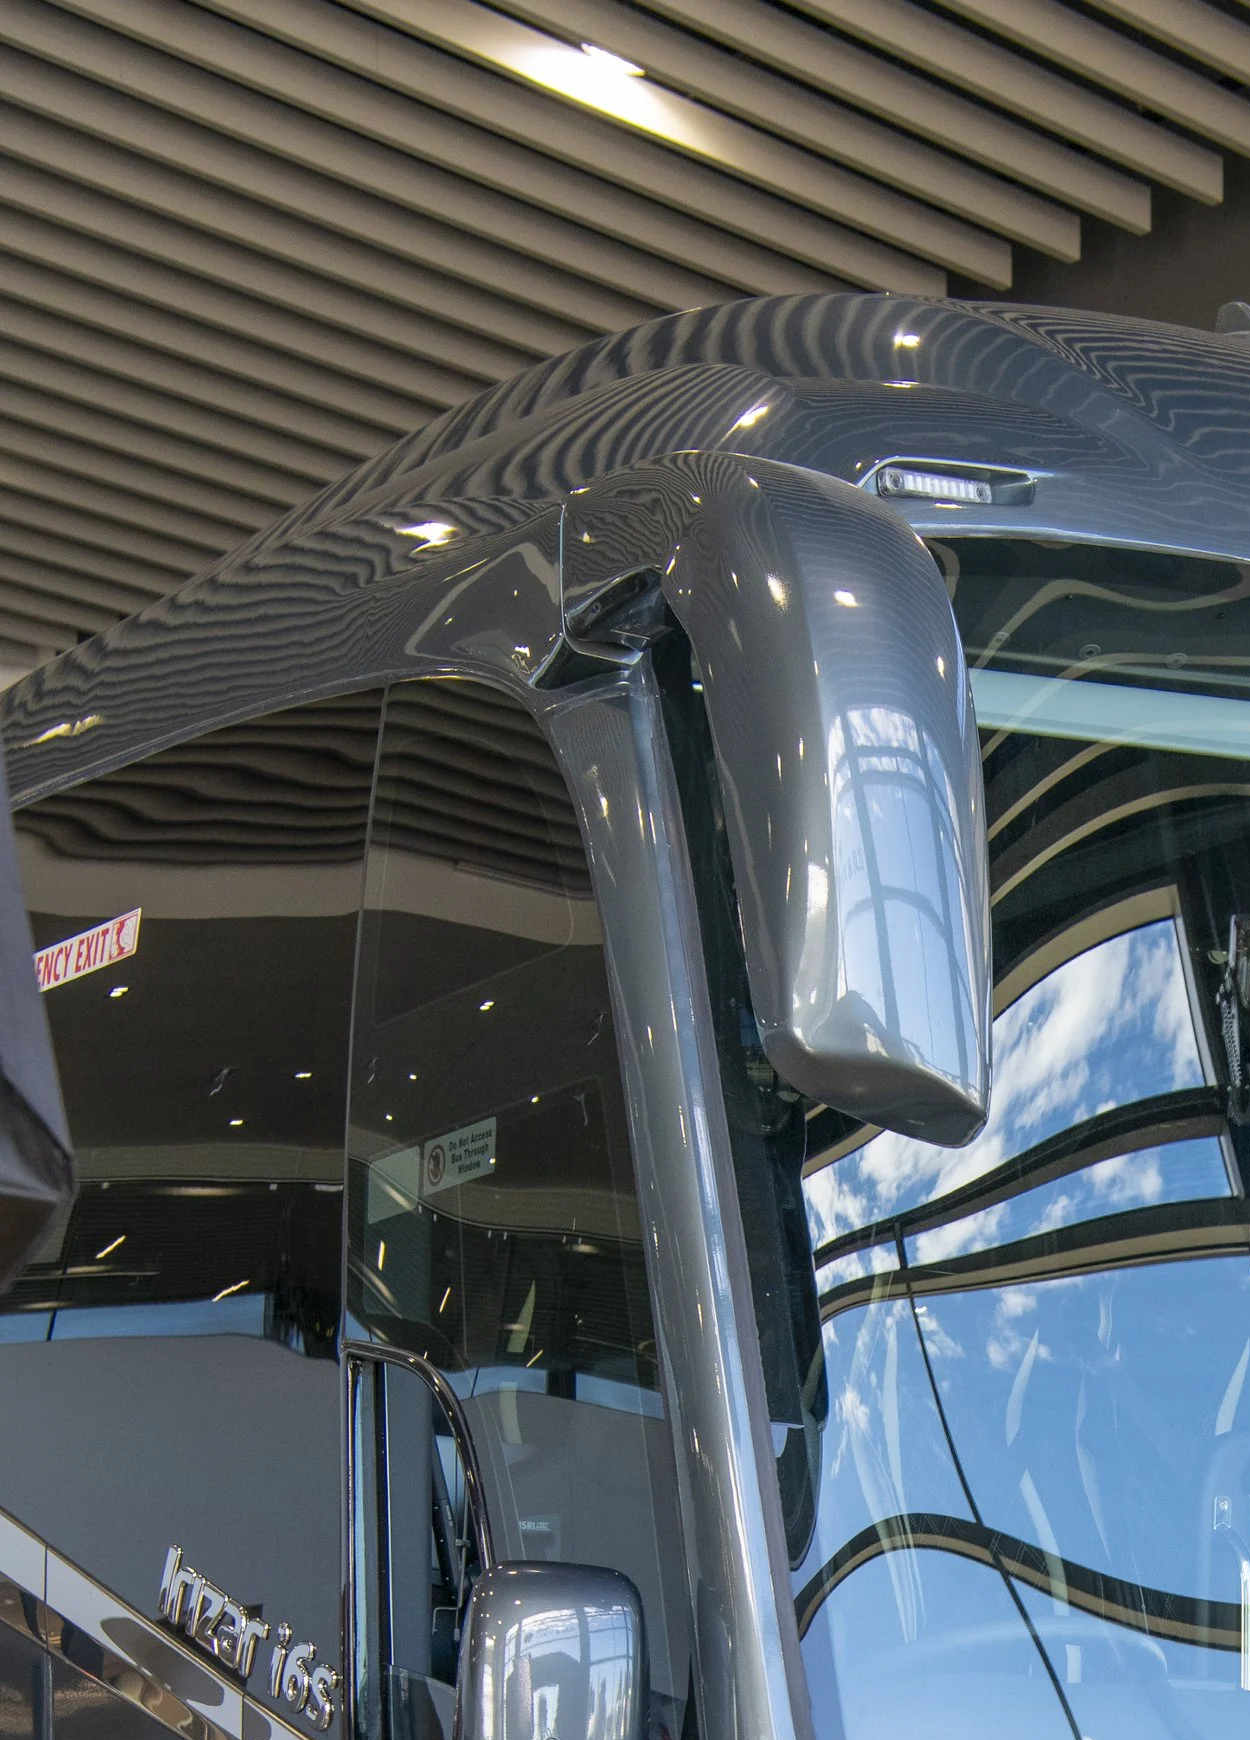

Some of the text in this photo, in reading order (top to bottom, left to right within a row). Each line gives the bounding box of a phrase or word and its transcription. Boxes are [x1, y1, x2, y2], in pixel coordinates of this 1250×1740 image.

[75, 928, 110, 974] EXIT
[449, 1129, 492, 1152] Do Not Access
[451, 1143, 489, 1164] Bus Through
[458, 1160, 480, 1174] Window
